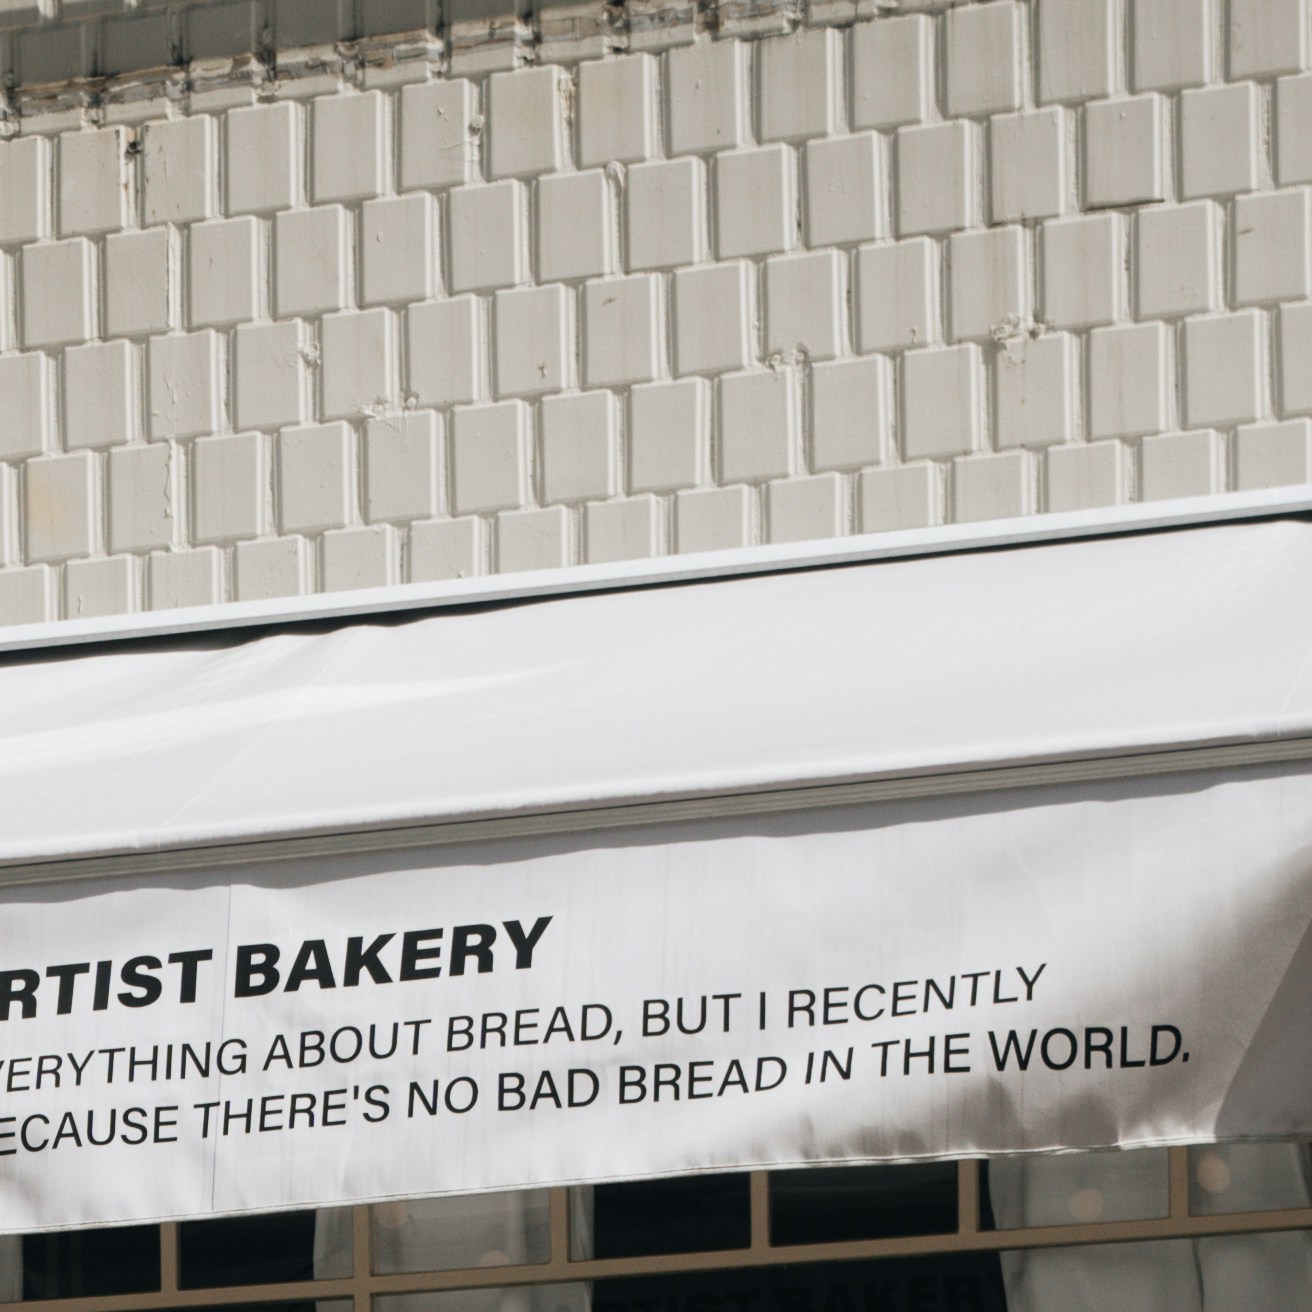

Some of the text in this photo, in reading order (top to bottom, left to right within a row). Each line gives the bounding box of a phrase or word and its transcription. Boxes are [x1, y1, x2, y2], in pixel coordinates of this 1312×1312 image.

[234, 916, 553, 998] BAKERY
[262, 1019, 432, 1071] ABOUT
[446, 1003, 623, 1052] BREAD,
[642, 993, 742, 1037] BUT
[759, 991, 766, 1030] I
[788, 963, 1047, 1028] RECENTLY
[193, 1084, 390, 1139] THERE'S
[407, 1076, 479, 1118] NO
[498, 1068, 600, 1111] BAD
[619, 1056, 787, 1104] BREAD
[805, 1047, 854, 1084] IN
[871, 1032, 971, 1077] THE
[988, 1024, 1191, 1072] WORLD.
